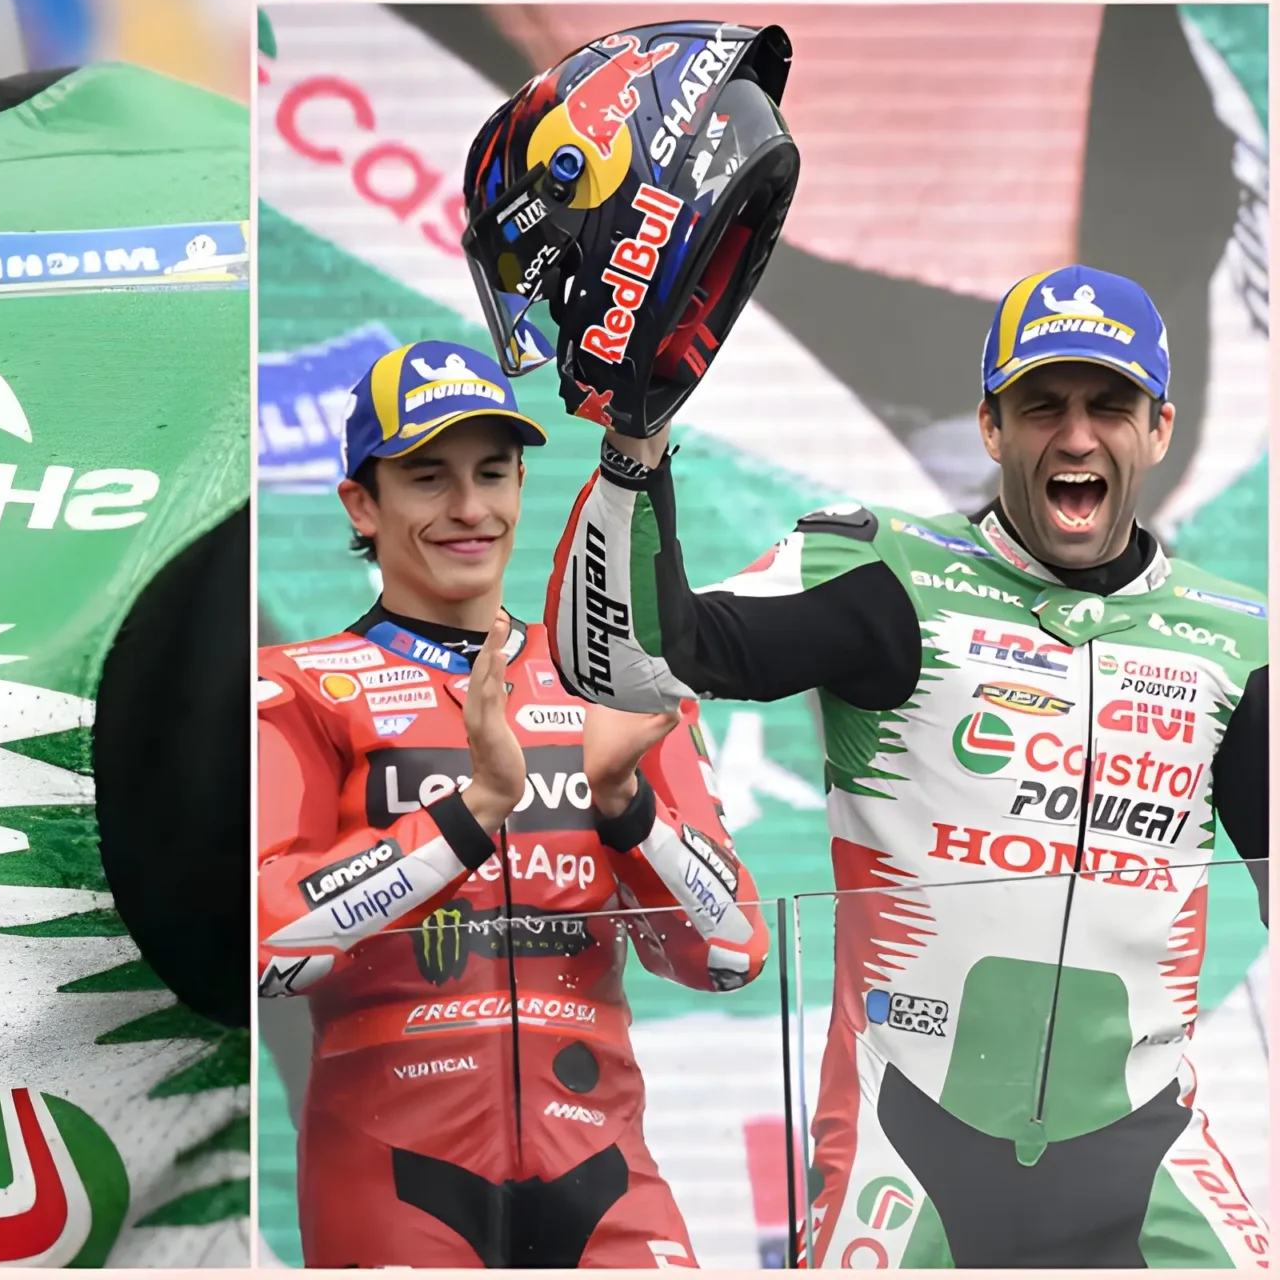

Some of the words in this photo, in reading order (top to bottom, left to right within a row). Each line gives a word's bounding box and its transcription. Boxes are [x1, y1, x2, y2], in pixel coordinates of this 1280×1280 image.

[969, 628, 1075, 673] HRC
[1097, 699, 1196, 744] GIVI
[1025, 731, 1205, 801] Castrol
[306, 843, 393, 902] Lenovo
[928, 822, 1180, 893] HONDA
[331, 866, 414, 930] Unipol
